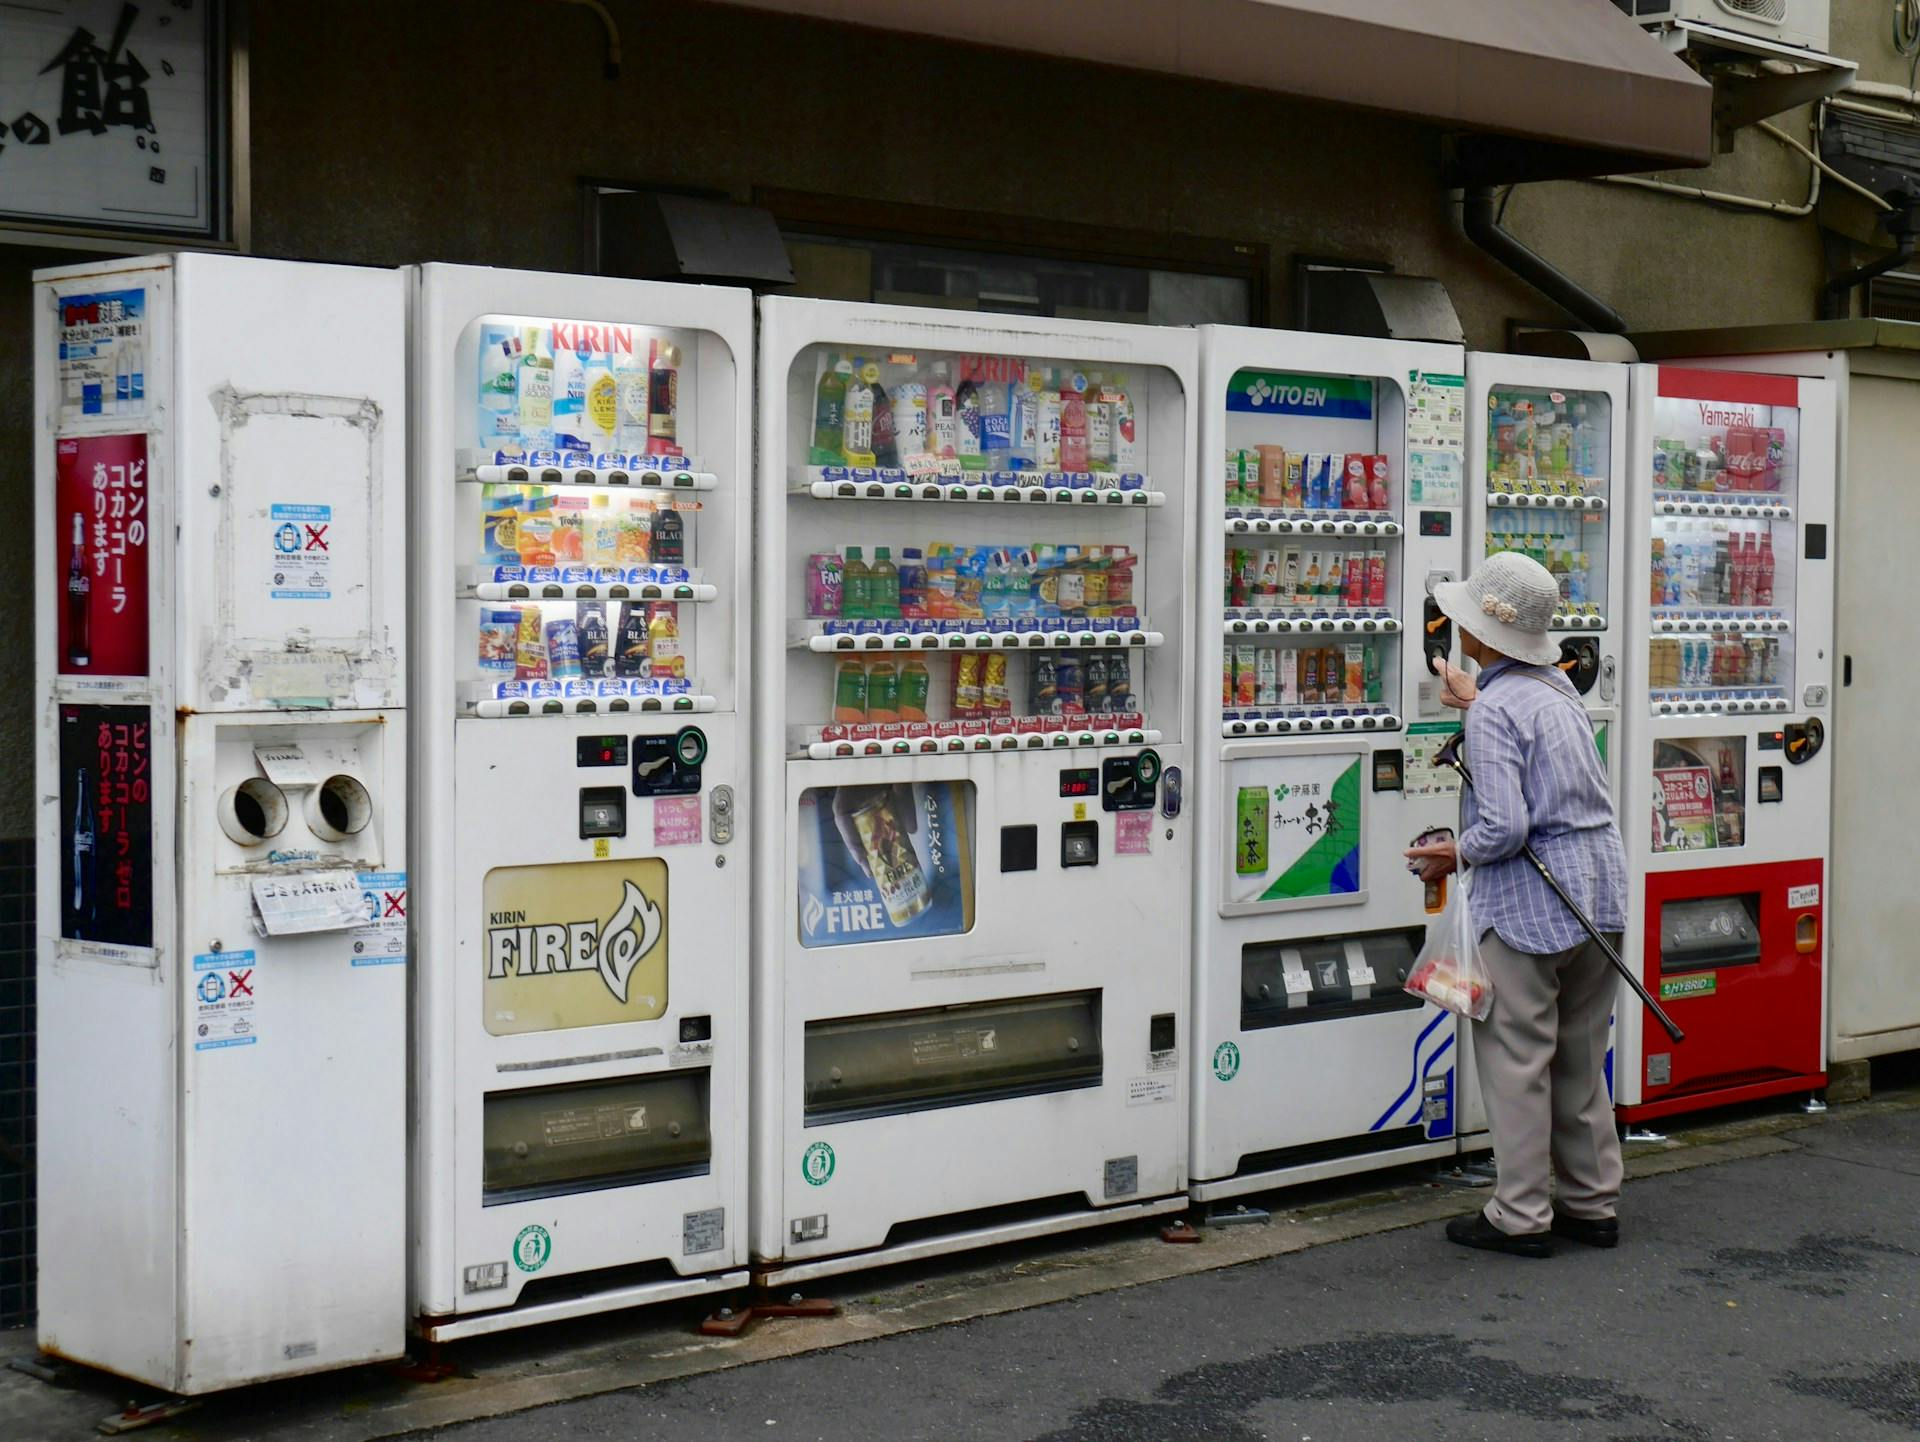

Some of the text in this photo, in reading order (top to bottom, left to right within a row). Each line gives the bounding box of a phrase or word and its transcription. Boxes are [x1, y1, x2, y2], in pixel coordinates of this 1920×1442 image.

[552, 322, 633, 354] KIRIN
[1270, 385, 1327, 407] ITO EN
[1698, 403, 1755, 428] Yamazaki
[92, 462, 110, 577] あります
[128, 460, 146, 546] ビンの
[110, 464, 127, 614] コカ・コーラ
[97, 722, 114, 835] あります
[132, 723, 148, 804] ビンの
[1291, 783, 1321, 798] 伊藤園
[114, 724, 133, 910] コカ・コーラ ゼロ
[924, 794, 945, 874] 心に火を。
[487, 918, 600, 980] FIRE
[490, 910, 526, 925] KIRIN
[824, 903, 886, 934] FIRE
